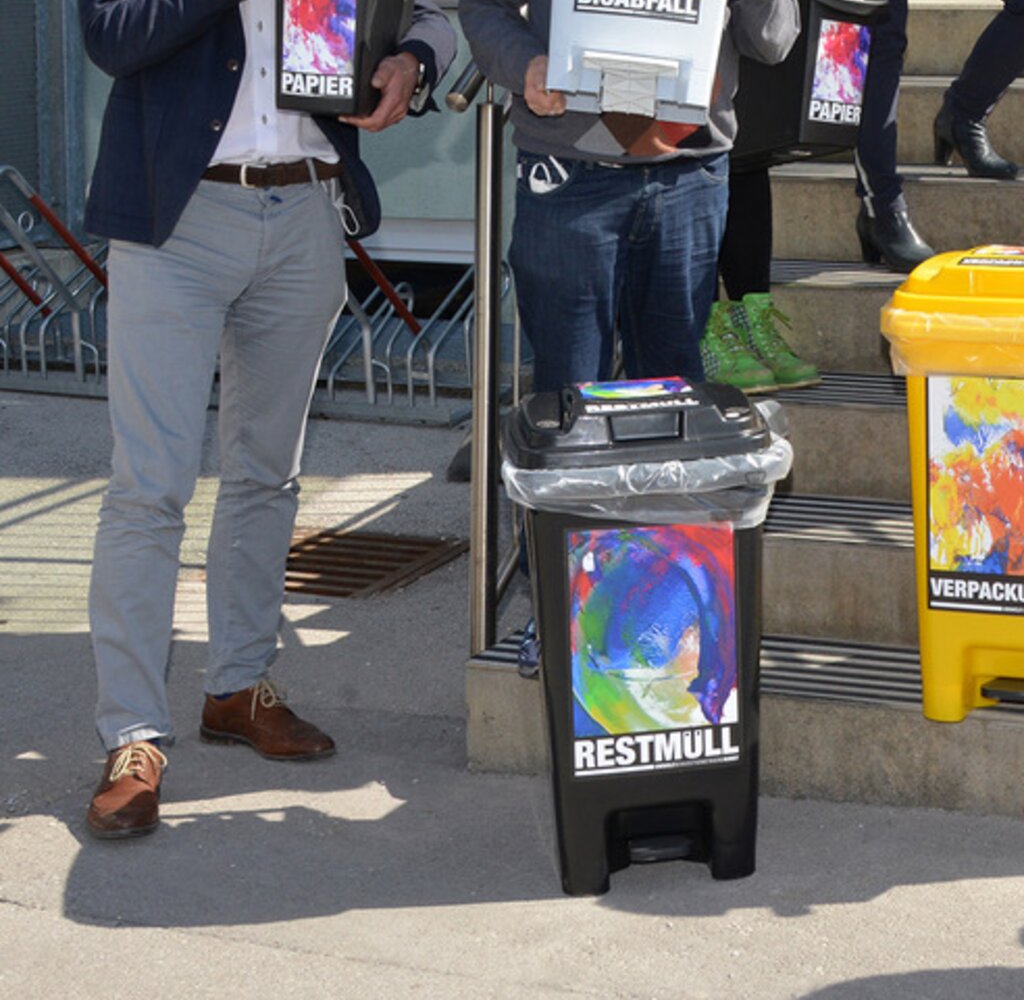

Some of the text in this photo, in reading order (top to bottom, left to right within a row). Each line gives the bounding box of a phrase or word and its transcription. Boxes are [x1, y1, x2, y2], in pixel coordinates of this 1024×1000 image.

[280, 71, 354, 97] PAPIER
[809, 100, 862, 125] PAPIER
[573, 726, 740, 769] RESTMÜLL
